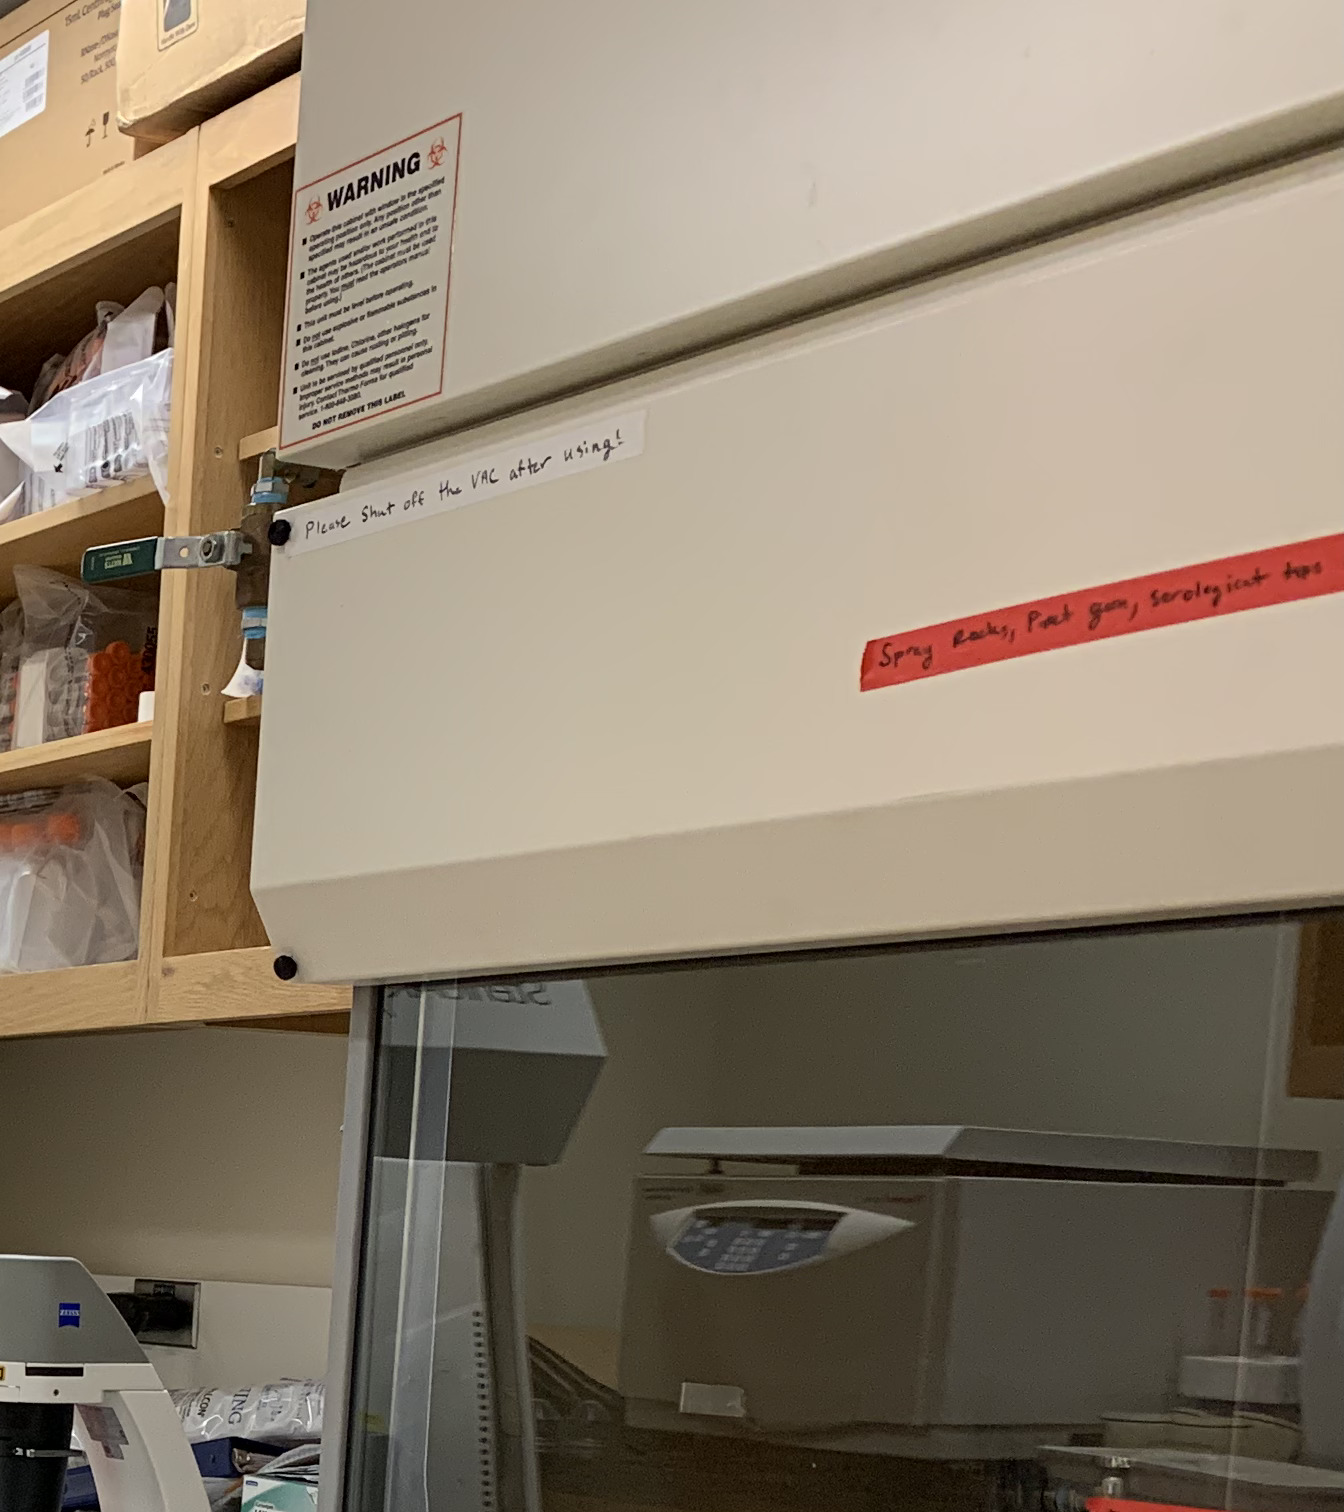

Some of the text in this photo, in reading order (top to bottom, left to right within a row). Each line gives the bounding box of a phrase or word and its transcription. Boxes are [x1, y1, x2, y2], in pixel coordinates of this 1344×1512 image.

[326, 151, 421, 212] WARNING
[312, 390, 405, 429] DO NOT REMOVE THIS LABEL
[305, 514, 351, 539] Please
[403, 490, 425, 511] off
[438, 481, 463, 501] the
[471, 468, 500, 490] VAC
[509, 454, 552, 482] after
[564, 428, 625, 465] using!
